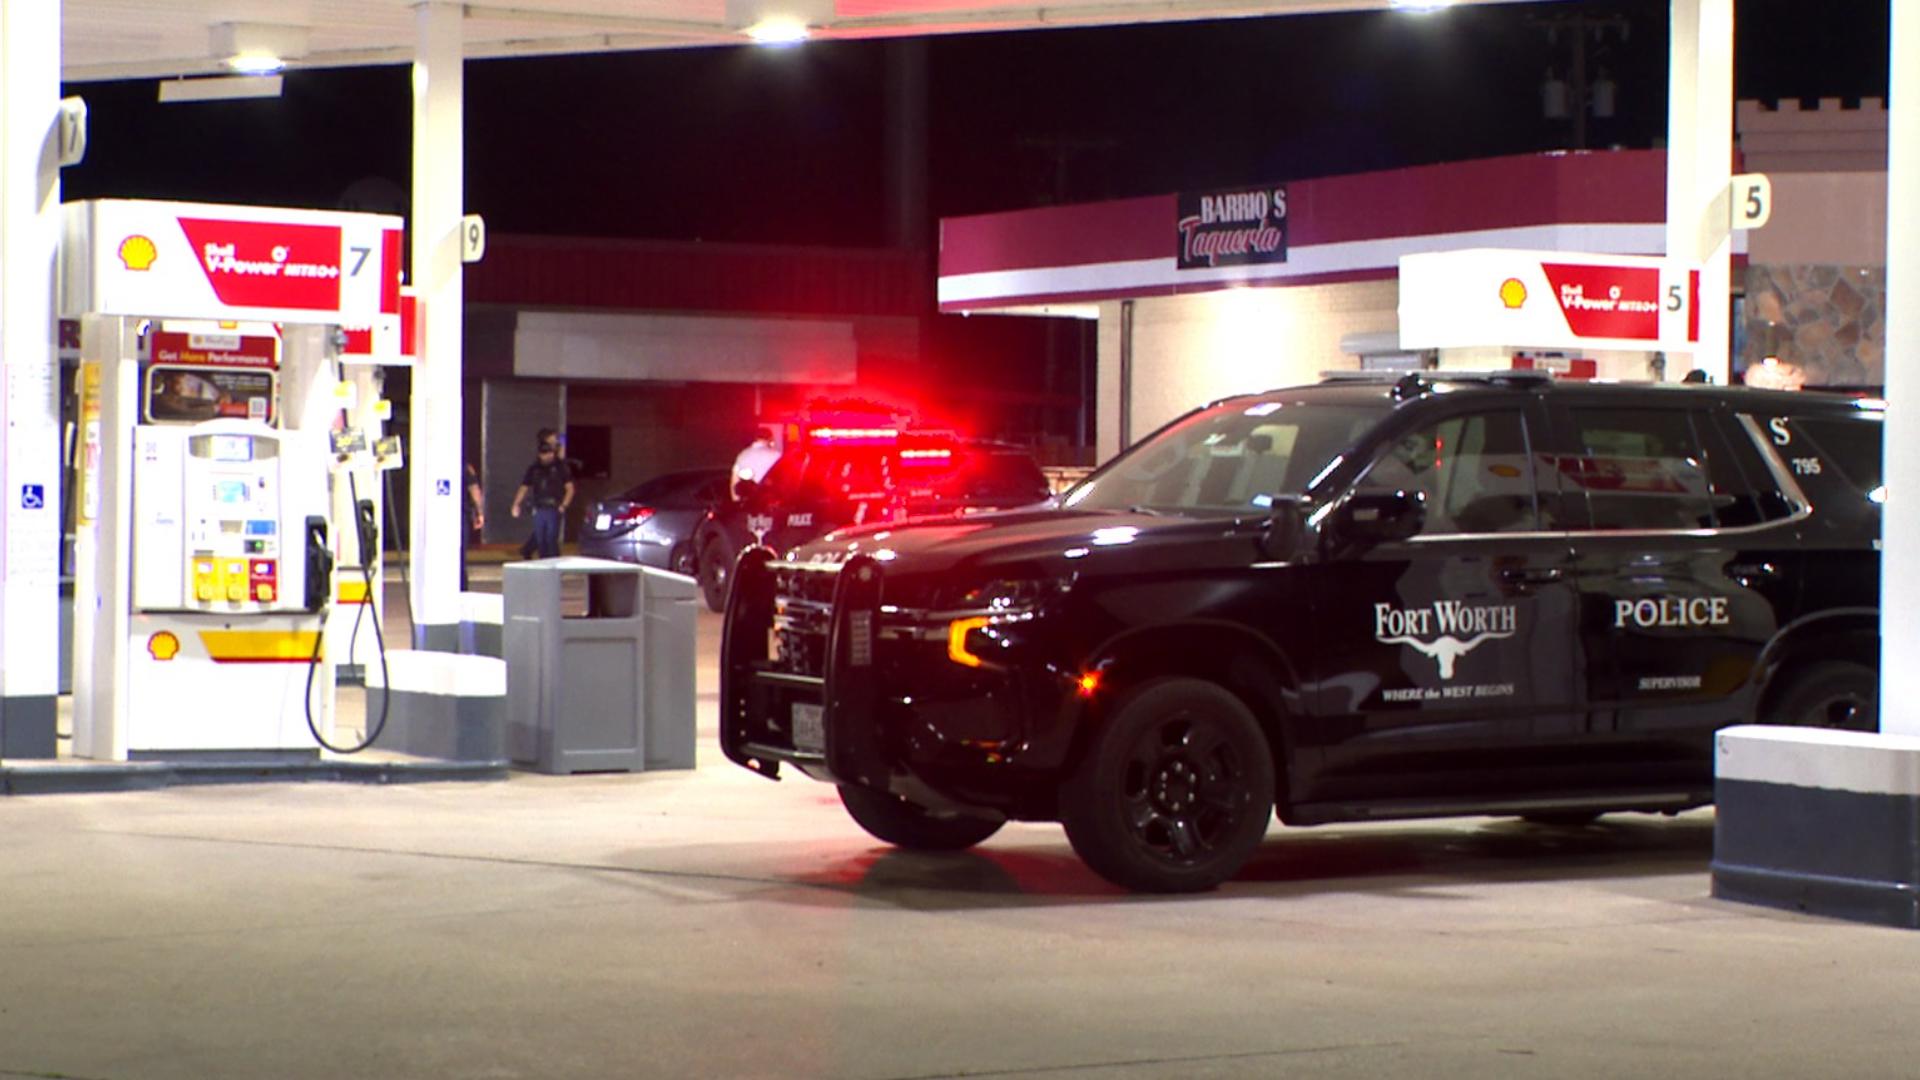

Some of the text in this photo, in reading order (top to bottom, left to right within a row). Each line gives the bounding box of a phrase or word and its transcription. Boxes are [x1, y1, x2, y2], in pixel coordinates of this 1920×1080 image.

[1201, 190, 1286, 223] BARRIO'S
[1746, 185, 1762, 219] 5
[468, 223, 480, 252] 9
[350, 246, 371, 277] 7
[1667, 285, 1682, 311] 5
[1770, 417, 1791, 446] S
[1792, 457, 1821, 475] 795
[1374, 600, 1517, 636] FORT WORTH
[1614, 597, 1730, 628] POLICE
